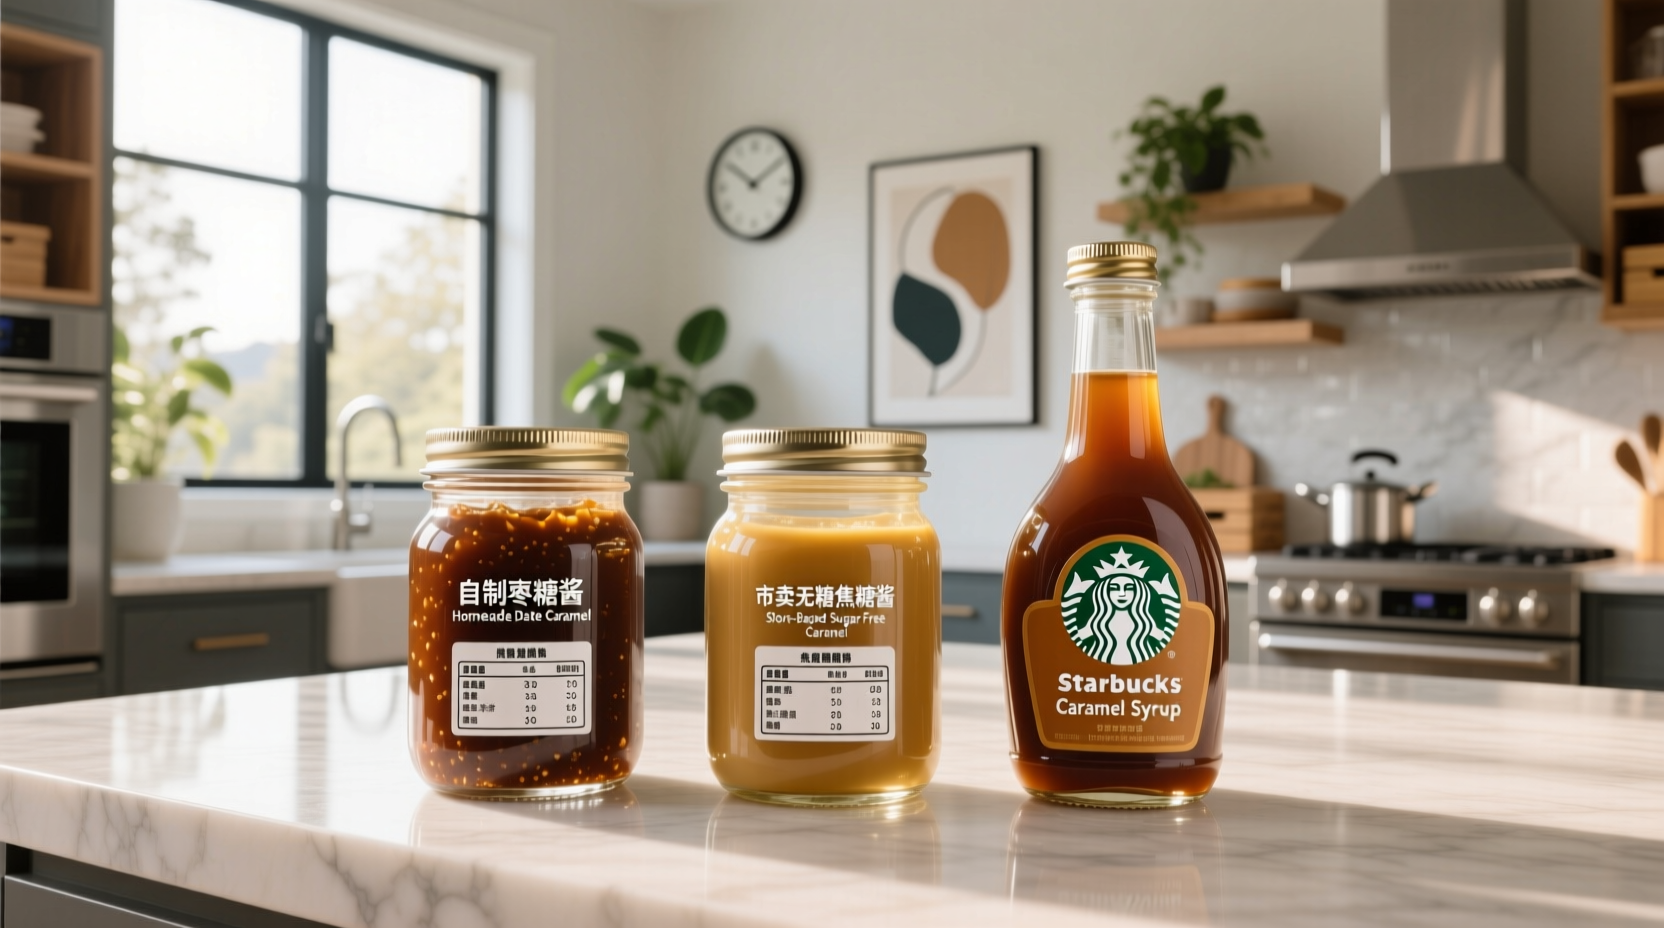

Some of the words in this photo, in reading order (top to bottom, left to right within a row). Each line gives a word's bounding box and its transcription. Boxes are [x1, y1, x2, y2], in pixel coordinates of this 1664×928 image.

[459, 578, 584, 607] 自制枣糖酱
[755, 584, 895, 609] 市卖无糖焦糖酱
[514, 609, 542, 622] Date
[545, 608, 591, 622] Caramel
[830, 611, 861, 628] Sugar
[862, 611, 886, 625] Free
[1057, 673, 1182, 694] Starbucks
[1055, 698, 1125, 716] Caramel
[1131, 699, 1182, 722] Syrup
